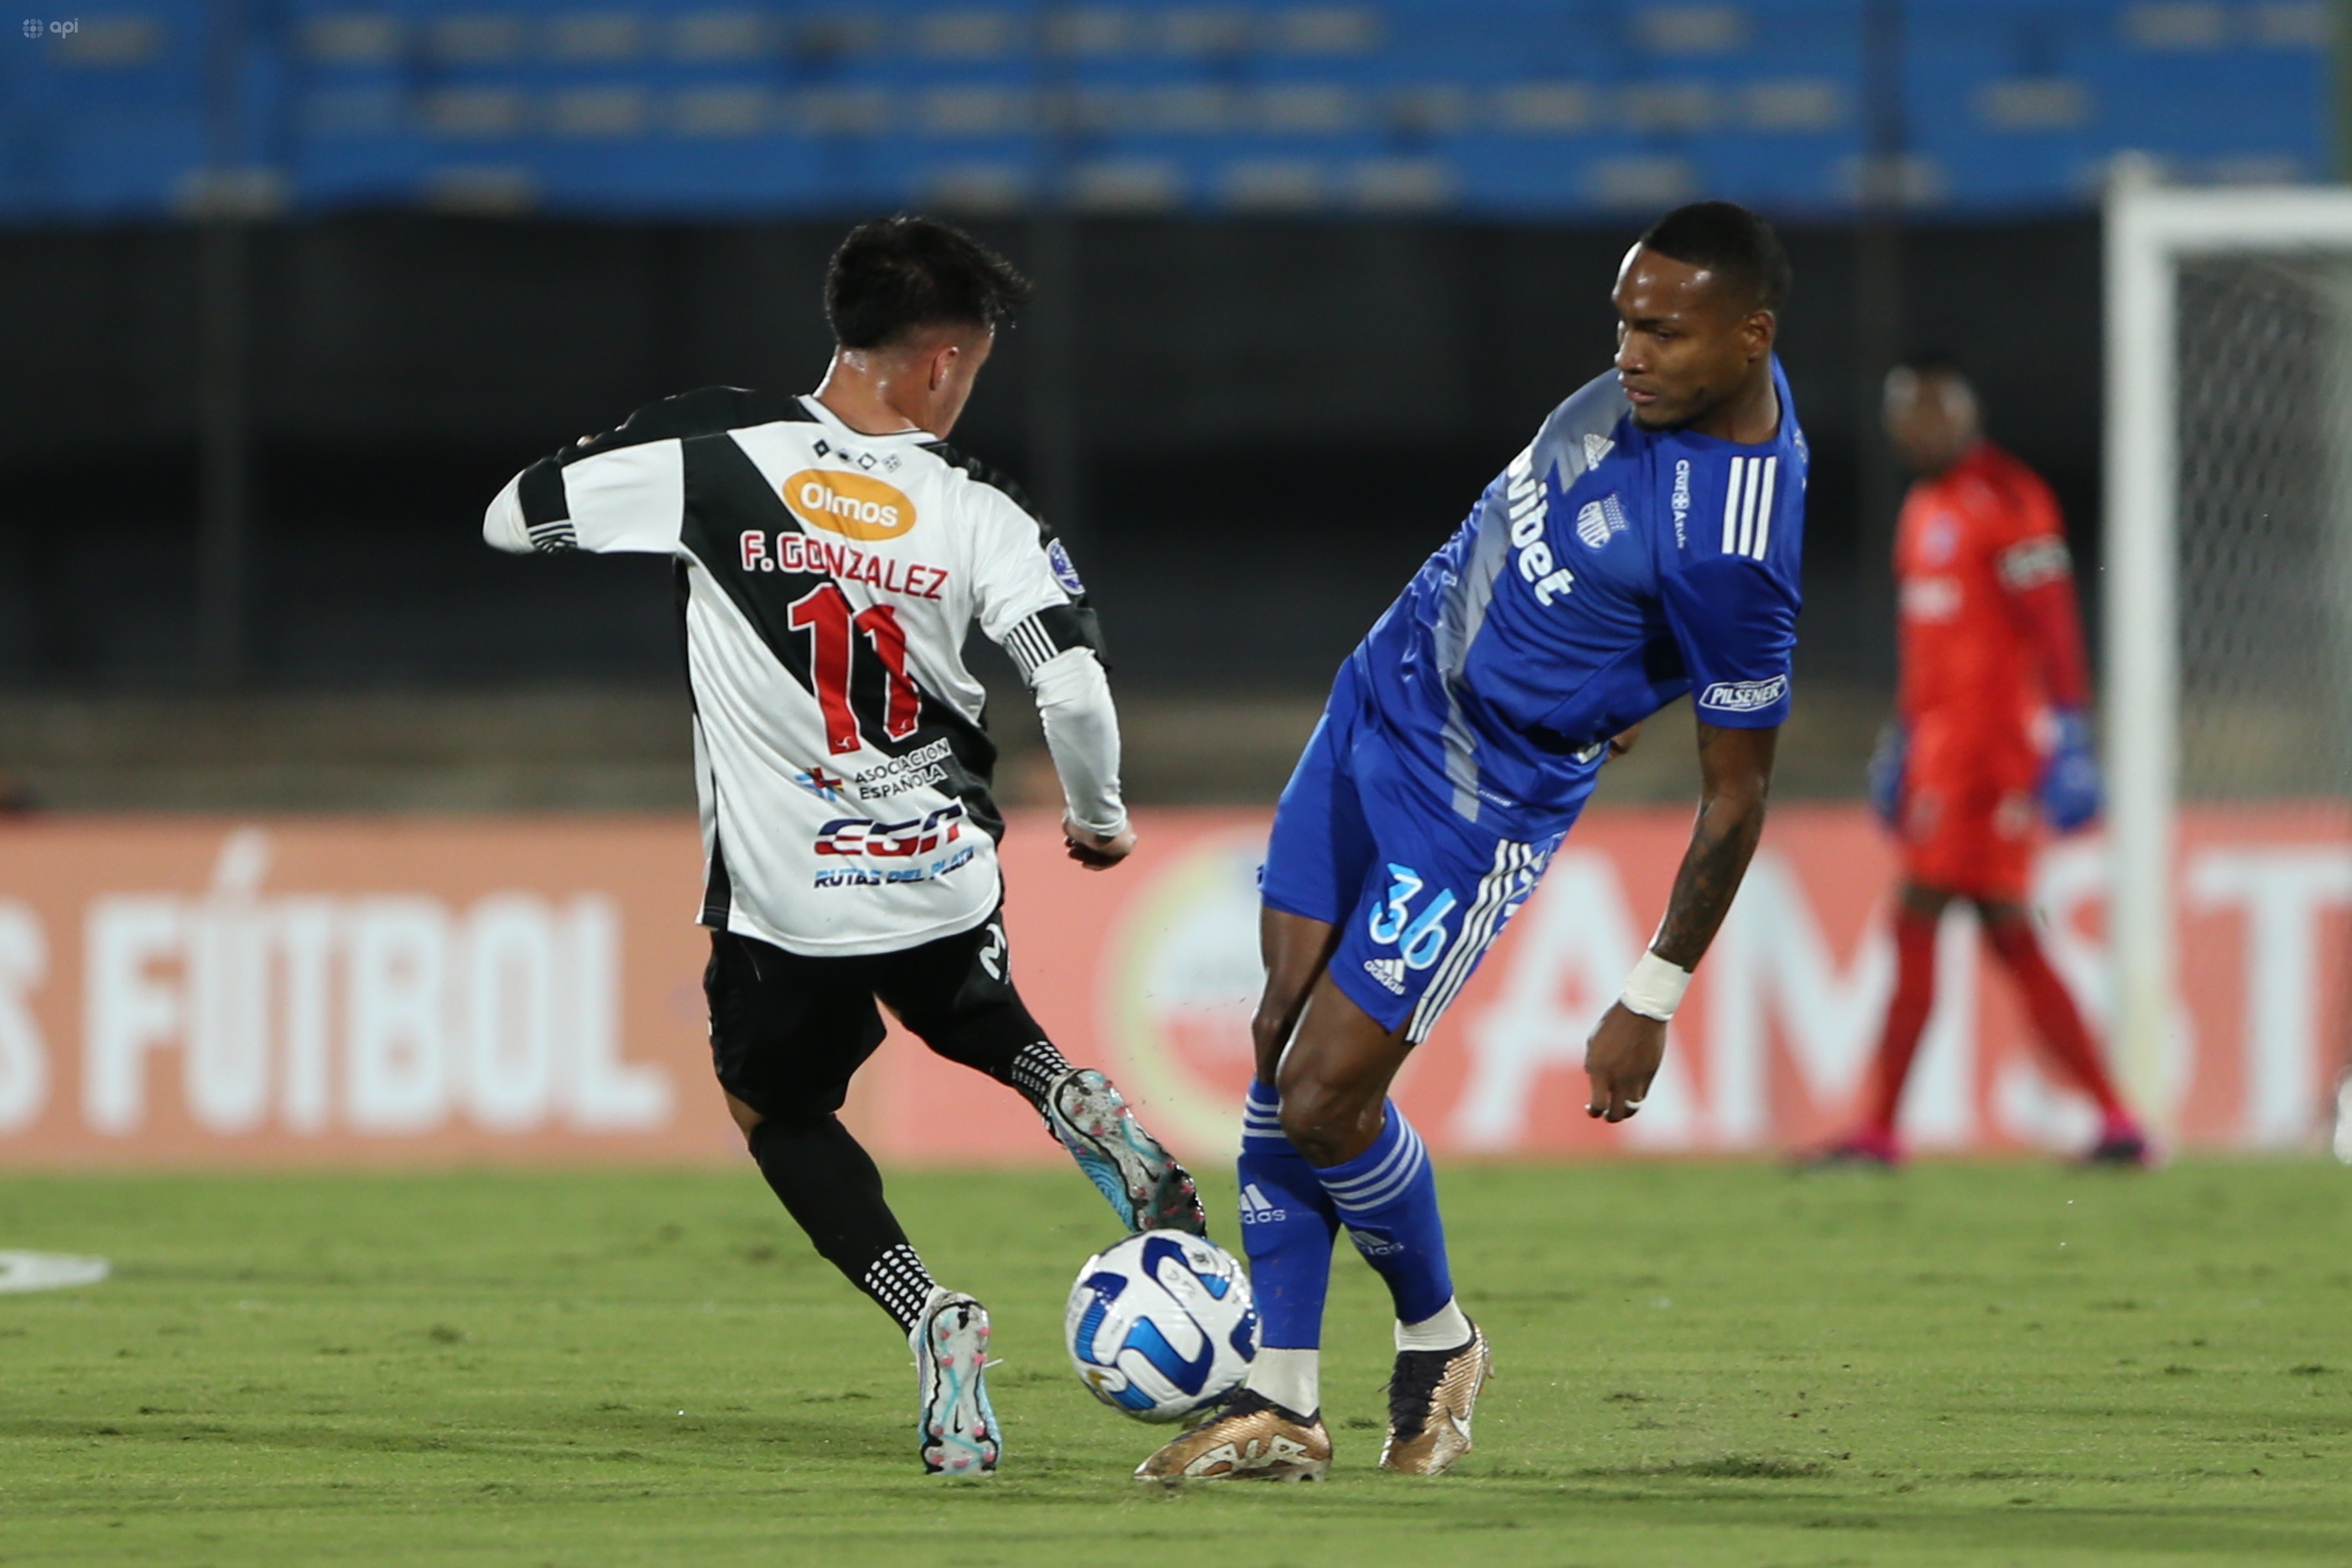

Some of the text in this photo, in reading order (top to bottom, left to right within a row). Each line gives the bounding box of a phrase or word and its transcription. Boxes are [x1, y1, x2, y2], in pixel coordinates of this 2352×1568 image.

[800, 482, 899, 528] Olmos
[777, 532, 948, 600] GONZALEZ
[787, 582, 922, 756] 11
[1710, 681, 1783, 705] PILSENER
[859, 764, 949, 800] ESPAÑOLA
[813, 868, 882, 889] RUTAS
[886, 868, 924, 884] DEL
[1369, 862, 1457, 970] 36
[84, 828, 670, 1131] FÚTBOL
[1363, 960, 1406, 995] adidas
[1455, 843, 2352, 1150] AMST
